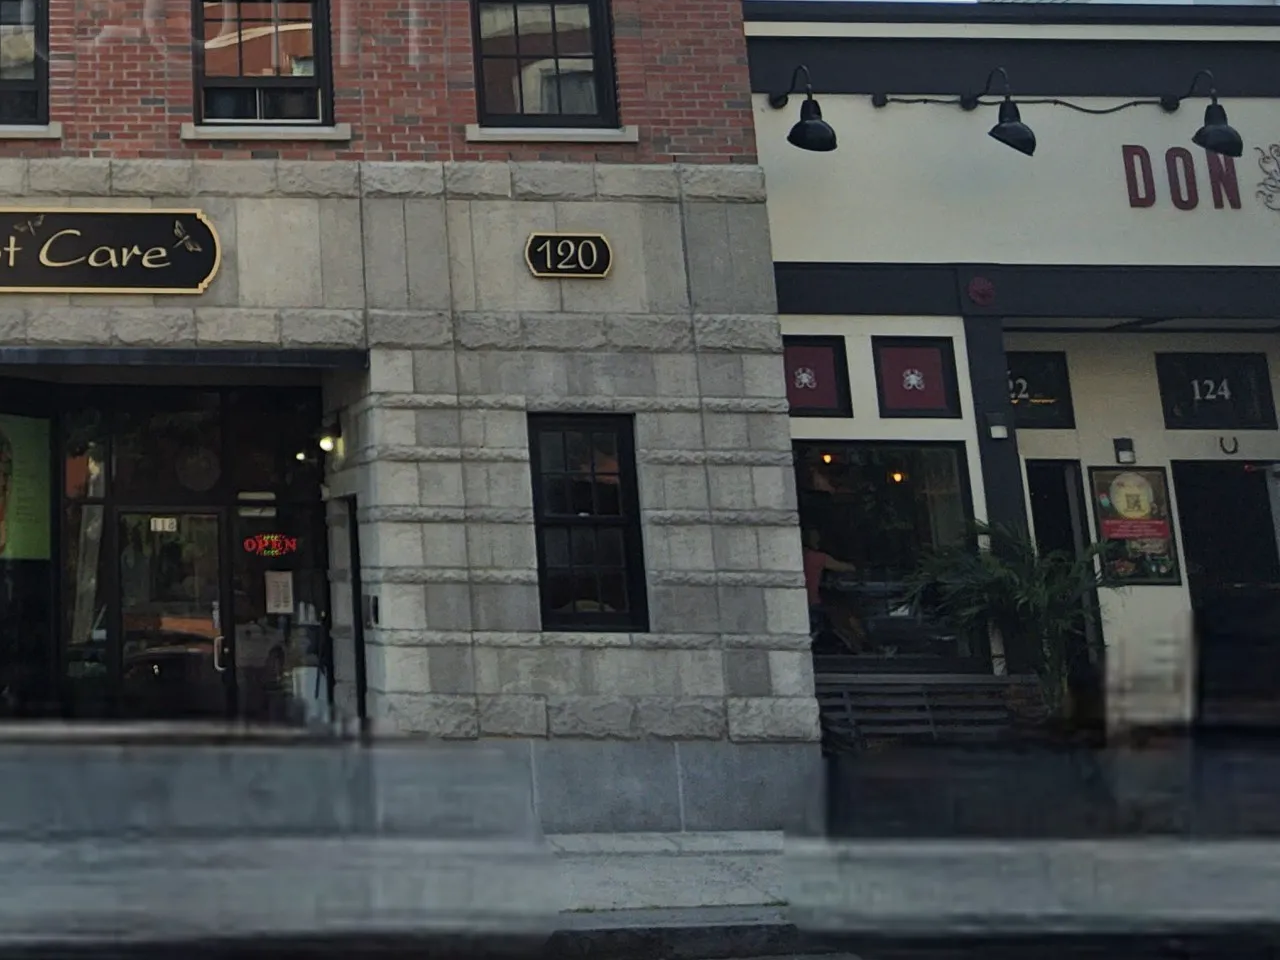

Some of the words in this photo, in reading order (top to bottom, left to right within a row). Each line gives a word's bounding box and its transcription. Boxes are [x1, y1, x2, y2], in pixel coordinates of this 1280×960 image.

[1122, 145, 1241, 210] DON
[38, 228, 172, 268] Care
[536, 239, 597, 270] 120
[1190, 378, 1231, 400] 124
[243, 538, 298, 553] OPEN
